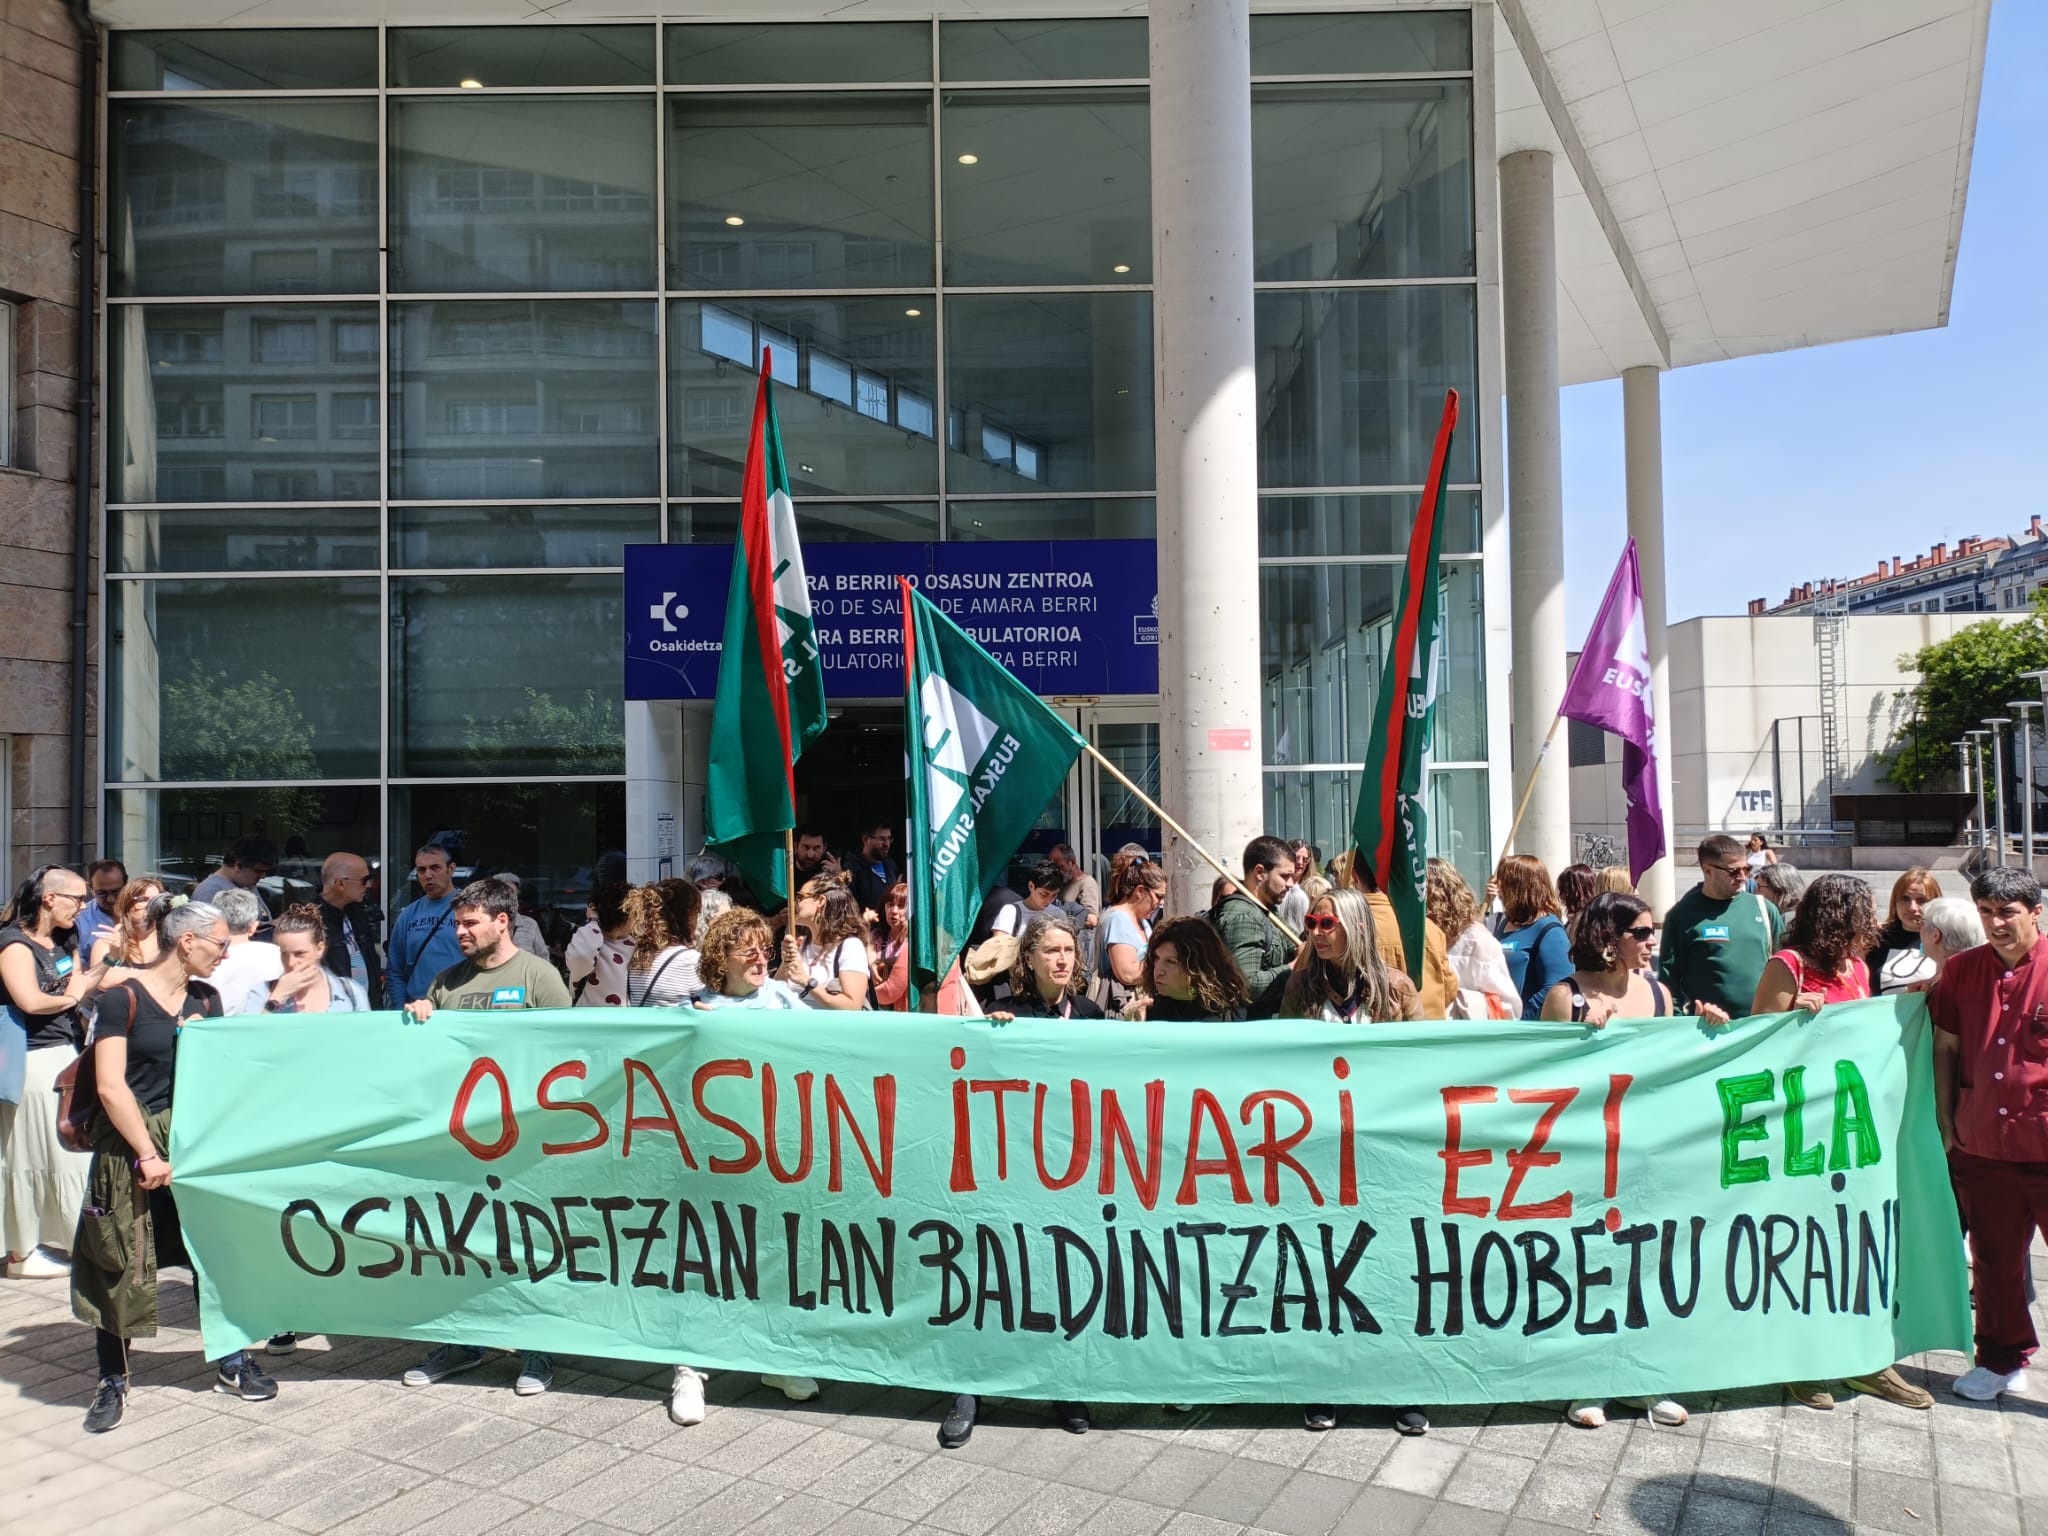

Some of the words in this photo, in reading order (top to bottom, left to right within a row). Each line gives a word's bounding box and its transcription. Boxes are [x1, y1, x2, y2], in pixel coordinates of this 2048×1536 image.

[806, 575, 829, 590] RA
[925, 573, 1001, 590] OSASUN
[1007, 572, 1093, 589] ZENTROA
[841, 599, 865, 615] DE
[872, 598, 904, 615] SAL
[940, 598, 964, 614] DE
[970, 597, 1035, 614] AMARA
[1042, 596, 1097, 613] BERRI
[649, 639, 723, 651] Osakidetza
[818, 629, 843, 645] RA
[849, 628, 904, 645] BERRI
[963, 626, 1082, 643] BULATORIOA
[822, 652, 904, 669] ULATORI
[991, 651, 1016, 667] RA
[1023, 650, 1077, 667] BERRI
[1602, 667, 1644, 699] EUS
[449, 1055, 896, 1198] OSASUN
[1715, 1059, 1882, 1190] ELA
[781, 1211, 896, 1317] LAN
[1410, 1215, 1706, 1337] HOBETU
